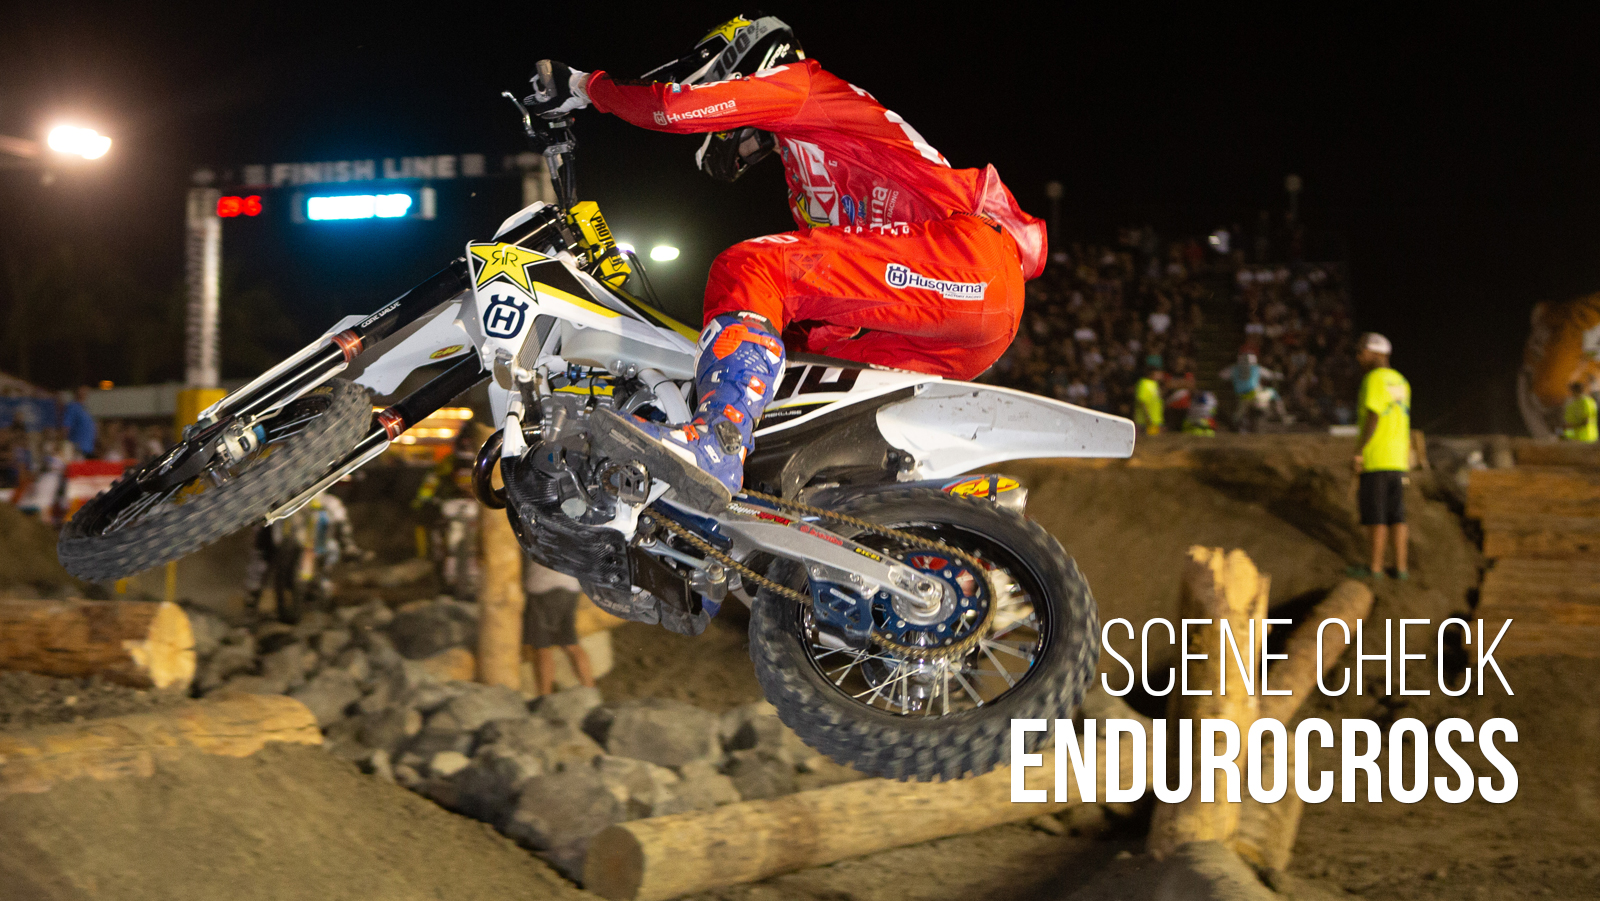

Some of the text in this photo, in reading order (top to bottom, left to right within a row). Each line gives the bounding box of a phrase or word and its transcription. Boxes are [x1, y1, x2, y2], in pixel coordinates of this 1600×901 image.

[667, 99, 737, 123] Husqvarna
[271, 154, 457, 186] FINISH LINE
[908, 274, 982, 294] Husqvarna
